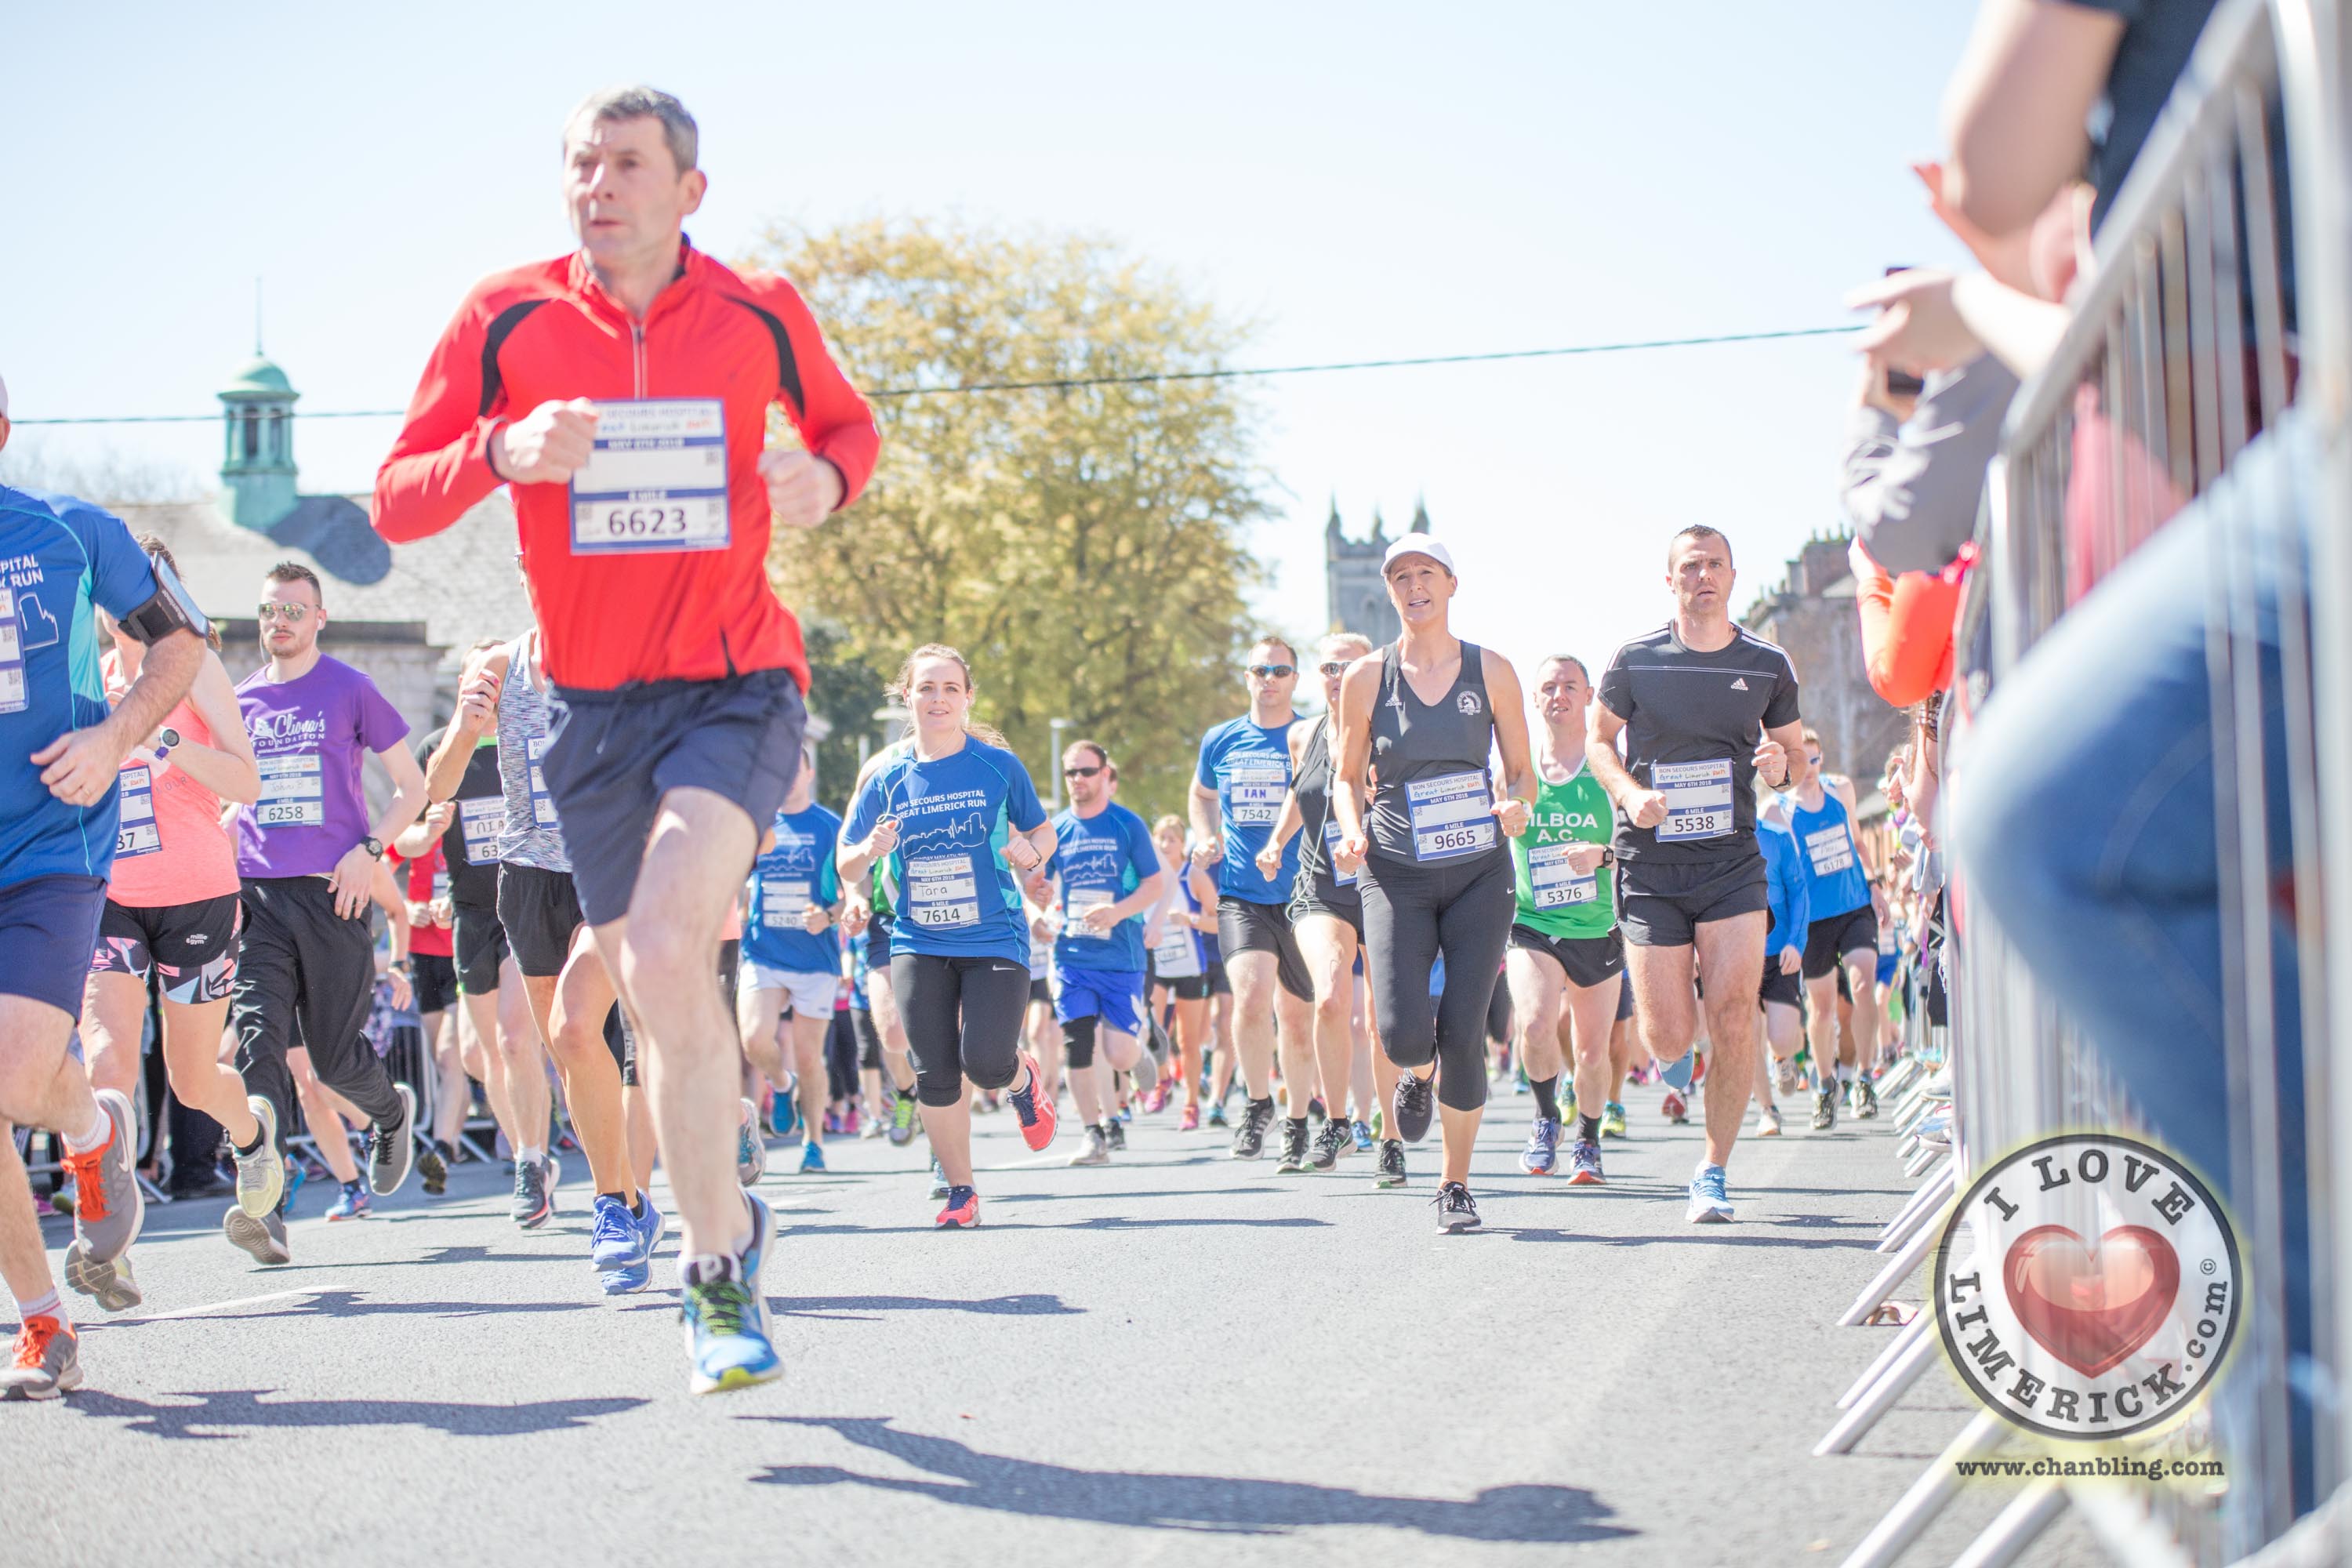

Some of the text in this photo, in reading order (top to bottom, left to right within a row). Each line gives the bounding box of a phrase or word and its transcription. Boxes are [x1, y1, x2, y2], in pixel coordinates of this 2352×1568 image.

[609, 507, 686, 536] 6623
[0, 554, 39, 575] PITAL
[10, 568, 44, 588] RUN
[252, 733, 326, 748] FOUNDATION
[1427, 779, 1453, 788] SECOURS
[1454, 775, 1480, 783] HOSPITAL
[1244, 789, 1266, 798] IAN
[1414, 789, 1438, 798] Great
[1440, 785, 1465, 793] Limerick
[895, 789, 985, 811] BON SECOURS HOSPITAL
[269, 806, 304, 822] 6258
[897, 799, 986, 819] GREAT LIMERICK RUN
[1241, 809, 1272, 820] 7542
[1527, 813, 1599, 829] ILBOA
[1675, 815, 1715, 833] 5538
[1434, 829, 1475, 850] 9665
[1537, 829, 1580, 843] A.C.
[918, 885, 948, 898] Tara
[1548, 887, 1582, 904] 5376
[923, 908, 961, 923] 7614
